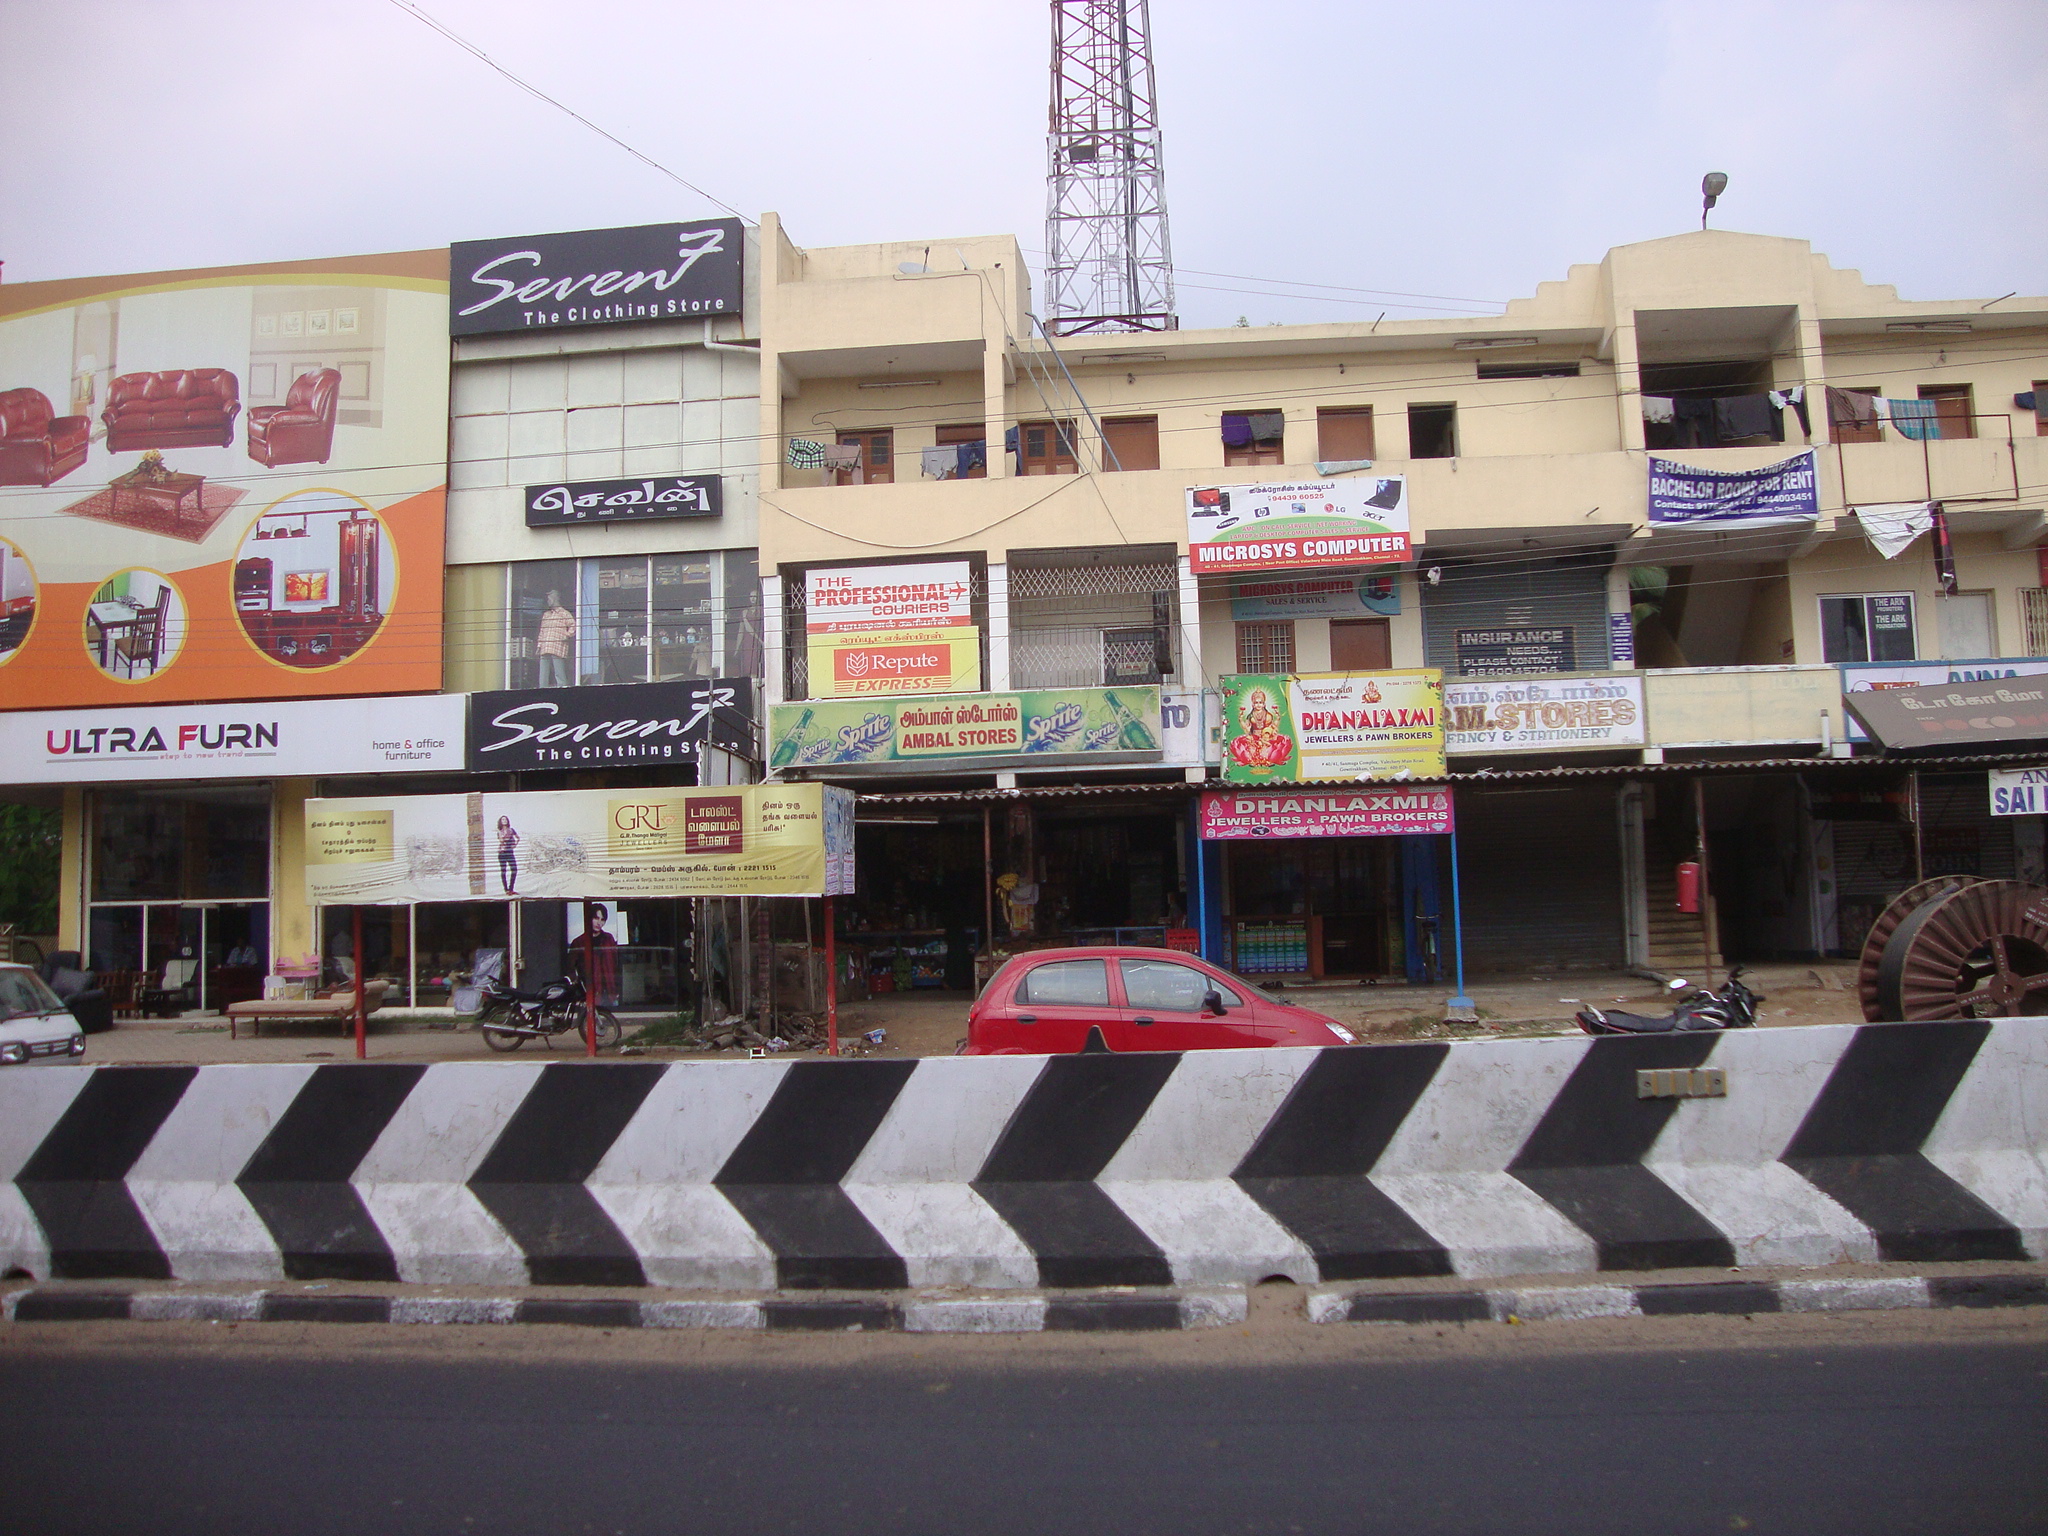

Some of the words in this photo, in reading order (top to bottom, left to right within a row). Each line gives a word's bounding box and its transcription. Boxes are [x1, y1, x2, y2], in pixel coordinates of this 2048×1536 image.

[524, 310, 559, 325] The
[568, 302, 659, 321] Clothing
[667, 298, 724, 313] Store
[1651, 478, 1714, 499] BACHELOR
[1716, 480, 1757, 499] ROOMS
[1758, 476, 1781, 492] FOR
[1782, 470, 1812, 490] RENT
[532, 480, 711, 515] செவன்
[1654, 500, 1694, 510] Contact:
[1757, 492, 1812, 504] 9444003451
[1362, 511, 1385, 520] acer
[1199, 542, 1297, 562] MICROSYS
[1302, 536, 1405, 556] COMPUTER
[815, 577, 852, 588] THE
[1240, 582, 1294, 597] MICROSYS
[1296, 580, 1354, 596] COMPUTER
[815, 583, 950, 607] PROFESSIONAL
[1266, 598, 1288, 606] SALES
[1297, 596, 1328, 605] SERVICE
[1874, 598, 1889, 606] THE
[1890, 598, 1905, 606] ARK
[872, 603, 950, 616] COURIERS
[1875, 615, 1890, 624] THE
[1891, 614, 1906, 622] ARK
[1461, 631, 1563, 646] INSURANCE
[872, 652, 938, 674] Repute
[1464, 658, 1508, 666] PLEASE
[855, 678, 932, 692] EXPRESS
[1900, 689, 2044, 710] டோகோமோ
[900, 708, 953, 728] அம்பாள்
[1027, 703, 1082, 742] Sprite
[1302, 708, 1434, 731] DHANALAXMI
[1920, 712, 2048, 732] DOCOM
[46, 726, 167, 754] ULTRA
[178, 722, 279, 750] FURN
[838, 713, 890, 750] Sprite
[902, 732, 954, 750] AMBAL
[958, 728, 1017, 746] STORES
[1085, 722, 1118, 743] Sprite
[1305, 735, 1354, 744] JEWELLERS
[1357, 734, 1362, 742] &
[1366, 734, 1390, 742] PAWN
[1393, 732, 1433, 740] BROKERS
[1502, 731, 1514, 742] &
[1518, 727, 1612, 741] STATIONERY
[372, 740, 401, 750] home
[404, 739, 413, 750] &
[416, 738, 445, 750] office
[537, 749, 572, 760] The
[581, 743, 672, 759] Clothing
[682, 741, 739, 754] Stre
[802, 738, 831, 758] Sprite
[385, 750, 432, 761] furniture
[762, 801, 783, 812] தினம்
[1235, 795, 1428, 814] DHANLAXMI
[1994, 786, 2035, 814] SAI
[615, 804, 668, 831] GRT
[688, 818, 740, 832] வளையல்
[762, 813, 780, 822] தங்க
[784, 812, 818, 820] வளையல்
[1206, 816, 1302, 826] JEWELLERS
[1320, 814, 1366, 824] PAWN
[1371, 812, 1448, 822] BROKERS
[714, 864, 736, 872] போன்
